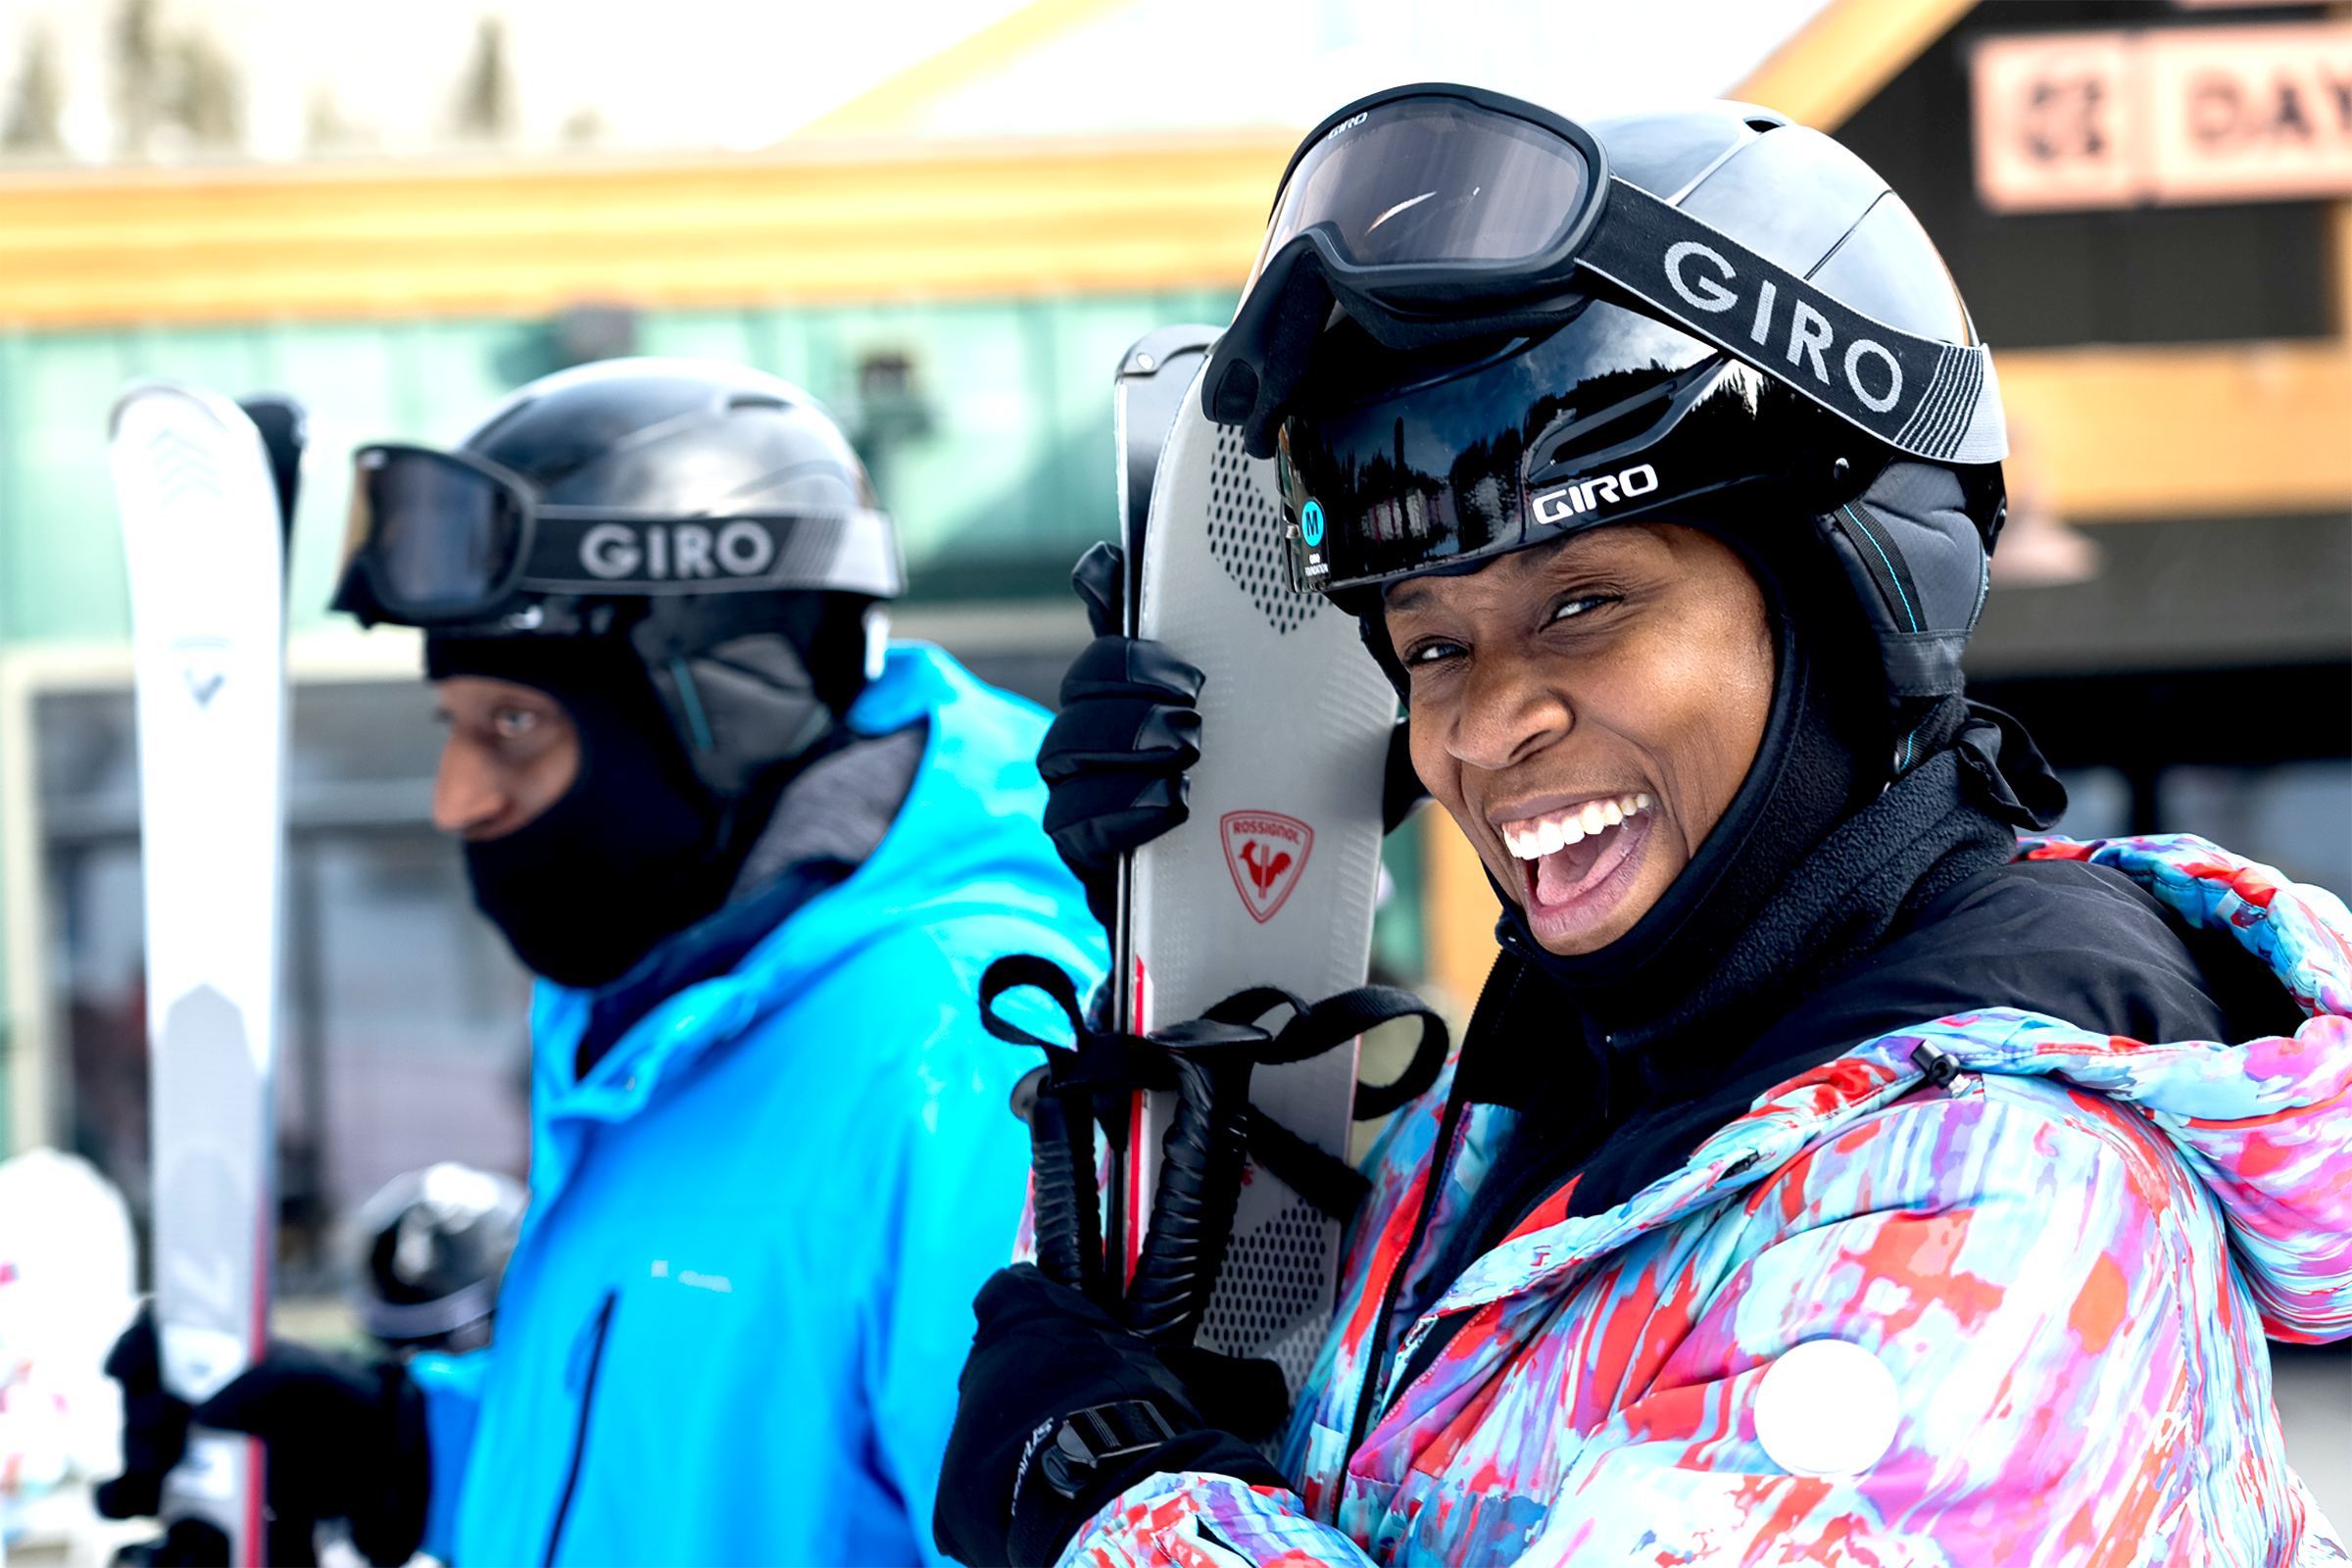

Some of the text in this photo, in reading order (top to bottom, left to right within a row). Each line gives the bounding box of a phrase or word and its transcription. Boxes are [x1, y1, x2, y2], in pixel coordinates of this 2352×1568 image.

[1327, 111, 1369, 141] GIRO
[1664, 240, 1903, 414] GIRO
[1532, 463, 1659, 525] GIRO
[1305, 510, 1319, 537] M
[579, 519, 774, 580] GIRO
[1232, 820, 1300, 846] ROSSIGNOL
